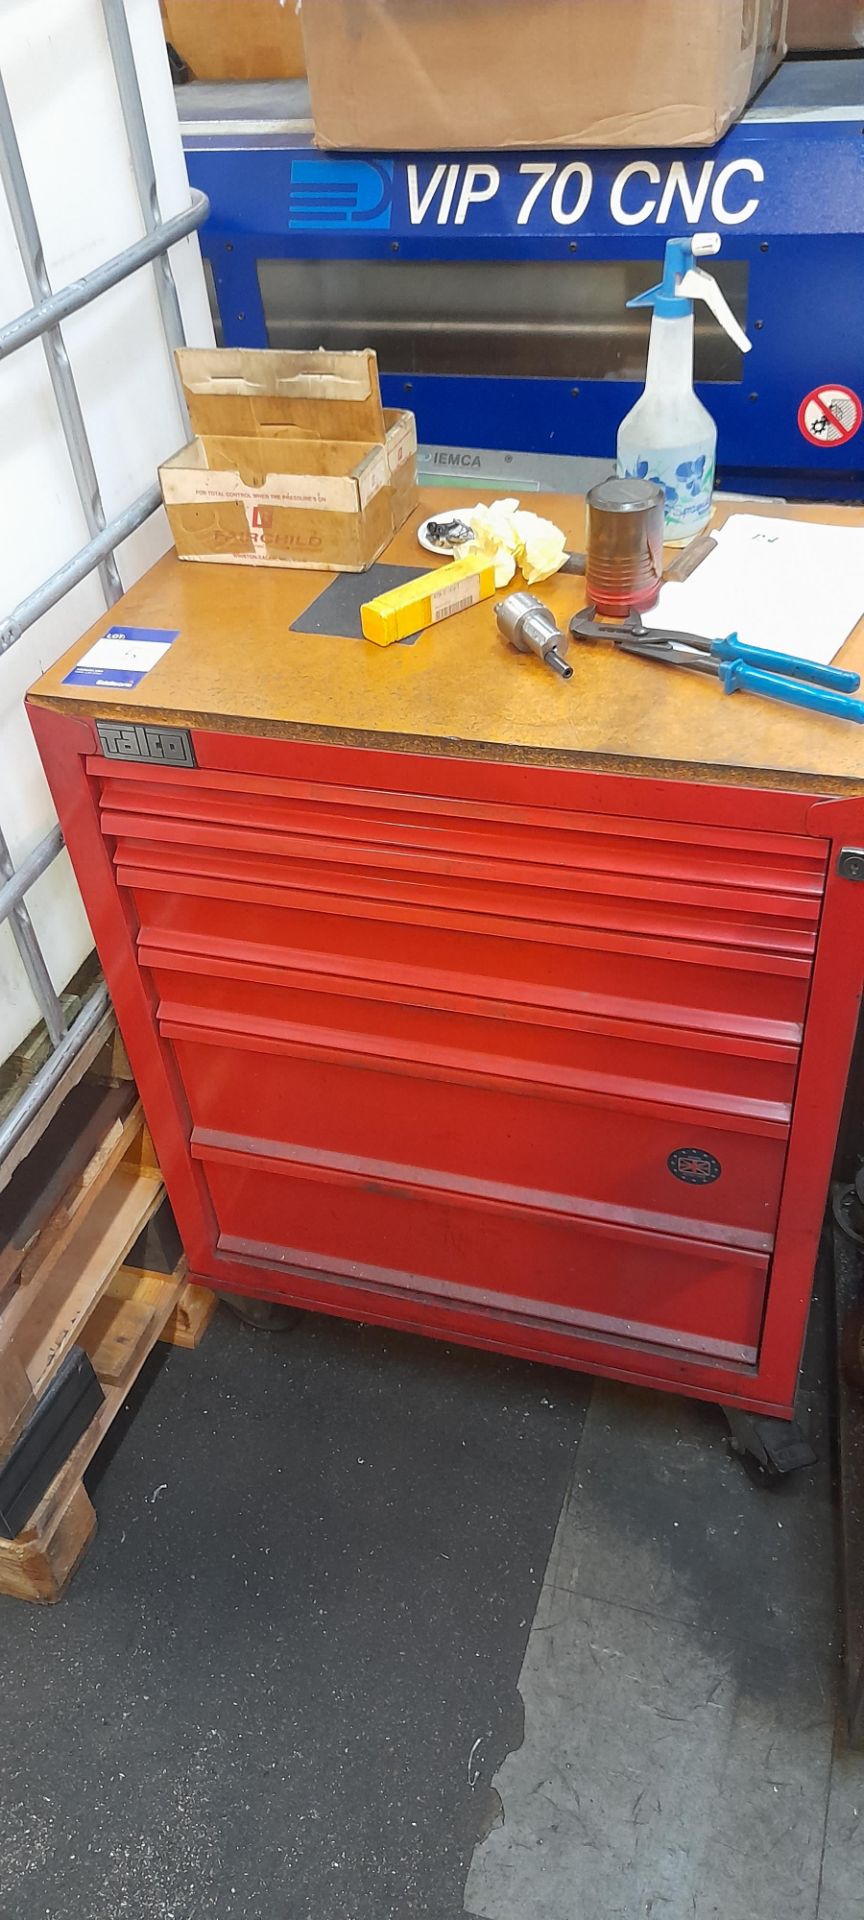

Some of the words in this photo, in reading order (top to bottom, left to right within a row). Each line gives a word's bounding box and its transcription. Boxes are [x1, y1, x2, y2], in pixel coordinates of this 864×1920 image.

[406, 163, 500, 226] VIP
[516, 162, 593, 225] 70
[609, 157, 765, 227] CNC
[433, 452, 481, 468] IEMCA
[225, 491, 251, 499] CONTROL
[213, 530, 323, 546] FAIRCHILD
